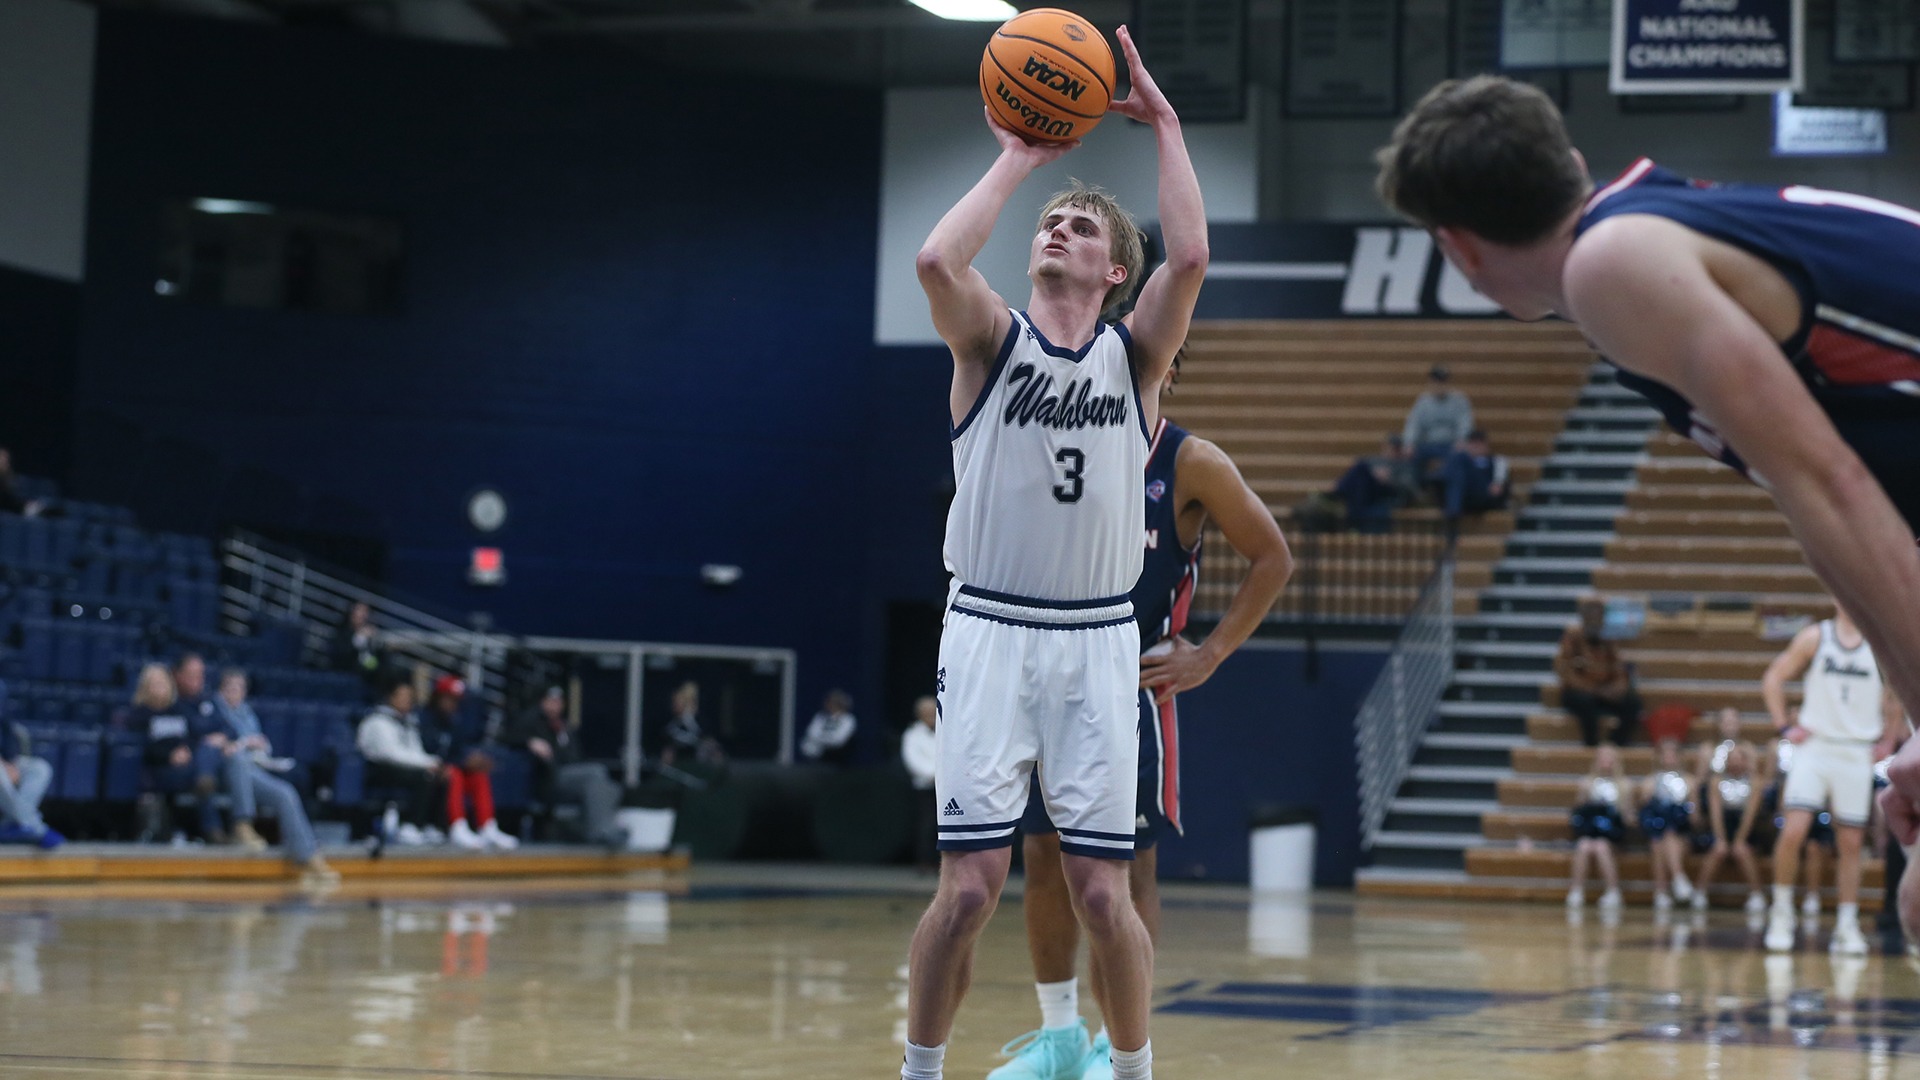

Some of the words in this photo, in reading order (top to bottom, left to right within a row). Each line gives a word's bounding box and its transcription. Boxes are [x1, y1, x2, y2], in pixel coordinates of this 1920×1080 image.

[1639, 15, 1777, 40] NATIONAL
[1023, 56, 1087, 102] NCAA
[1629, 43, 1787, 69] CHAMPIONS
[995, 80, 1074, 137] Wilson
[1005, 361, 1128, 431] Washburn
[1052, 446, 1086, 505] 3
